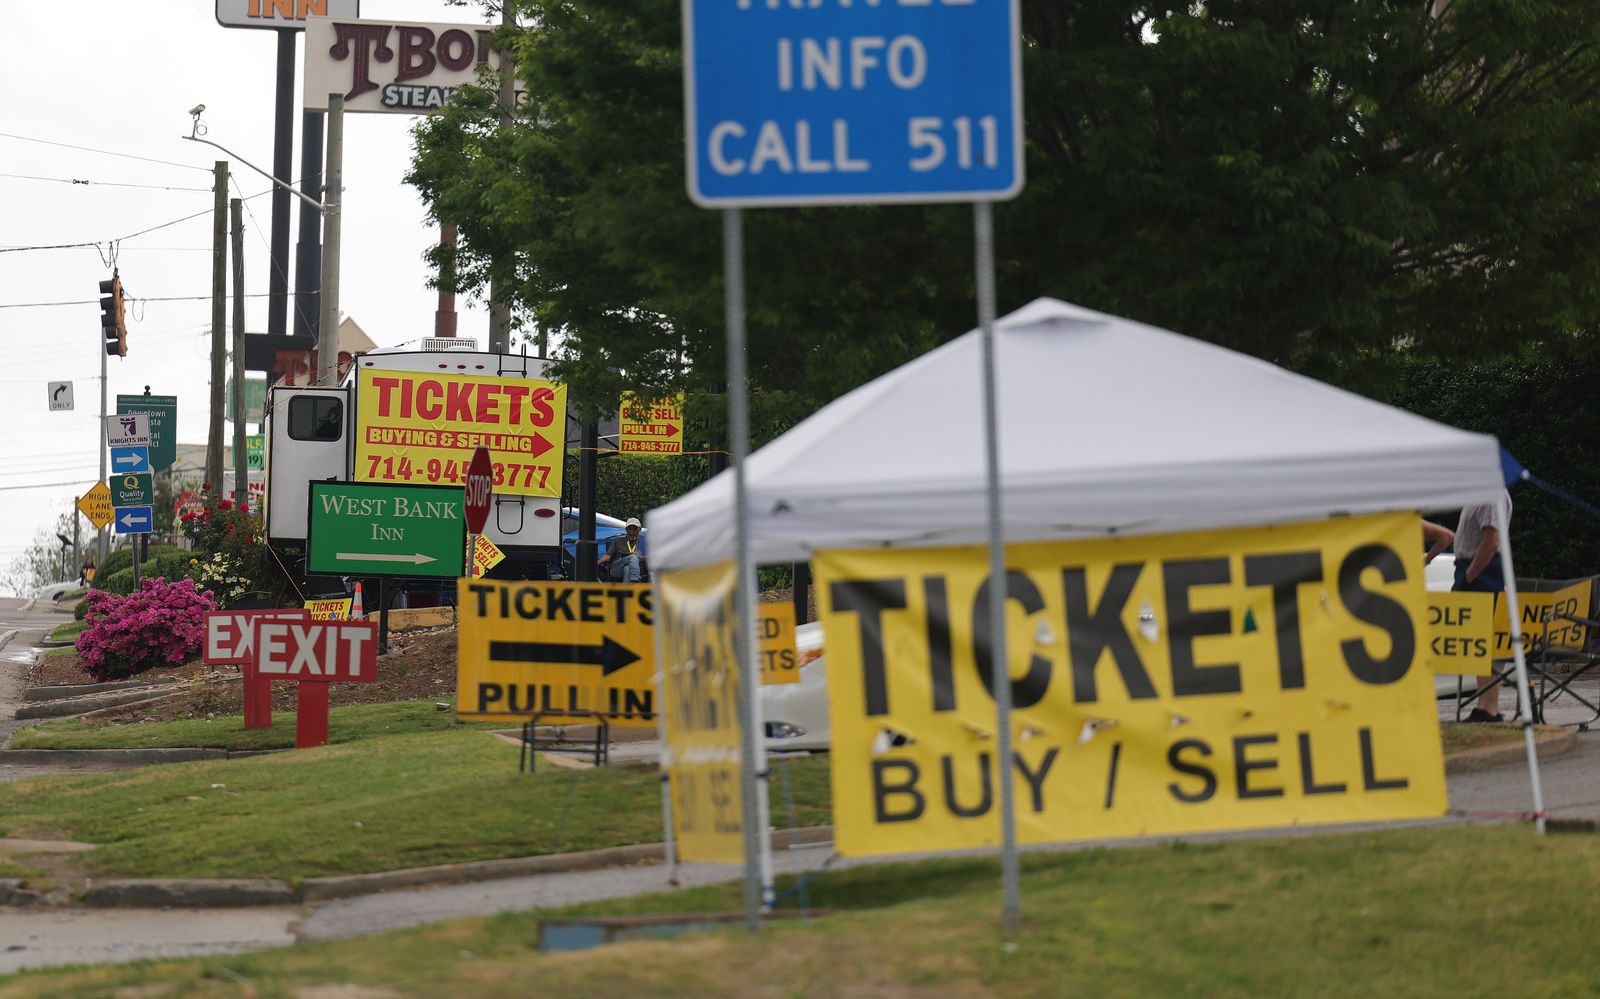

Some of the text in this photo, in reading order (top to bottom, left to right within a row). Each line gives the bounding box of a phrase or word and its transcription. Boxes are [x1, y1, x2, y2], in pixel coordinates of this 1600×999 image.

[777, 34, 928, 91] INFO
[707, 115, 998, 176] CALL 511
[52, 402, 71, 410] ONLY
[372, 377, 555, 428] TICKETS
[655, 408, 680, 420] SELL
[369, 428, 439, 446] BUYING
[457, 434, 532, 452] SELLING
[623, 425, 667, 435] PULL IN
[623, 441, 679, 452] 714-945-3777
[367, 454, 552, 489] 714-9453777
[120, 490, 144, 499] Quality
[466, 474, 491, 507] STOP
[90, 502, 111, 510] LANE
[91, 511, 110, 519] ENDS
[320, 494, 458, 519] WEST BANK
[370, 523, 405, 541] INN
[475, 535, 499, 559] ICKETS
[312, 601, 344, 612] TICKETS
[468, 584, 655, 626] TICKETS
[1428, 606, 1472, 626] OLF
[827, 543, 1416, 716] TICKETS
[259, 624, 372, 676] EXIT
[478, 683, 654, 720] PULL IN
[870, 726, 1409, 823] BUY / SELL
